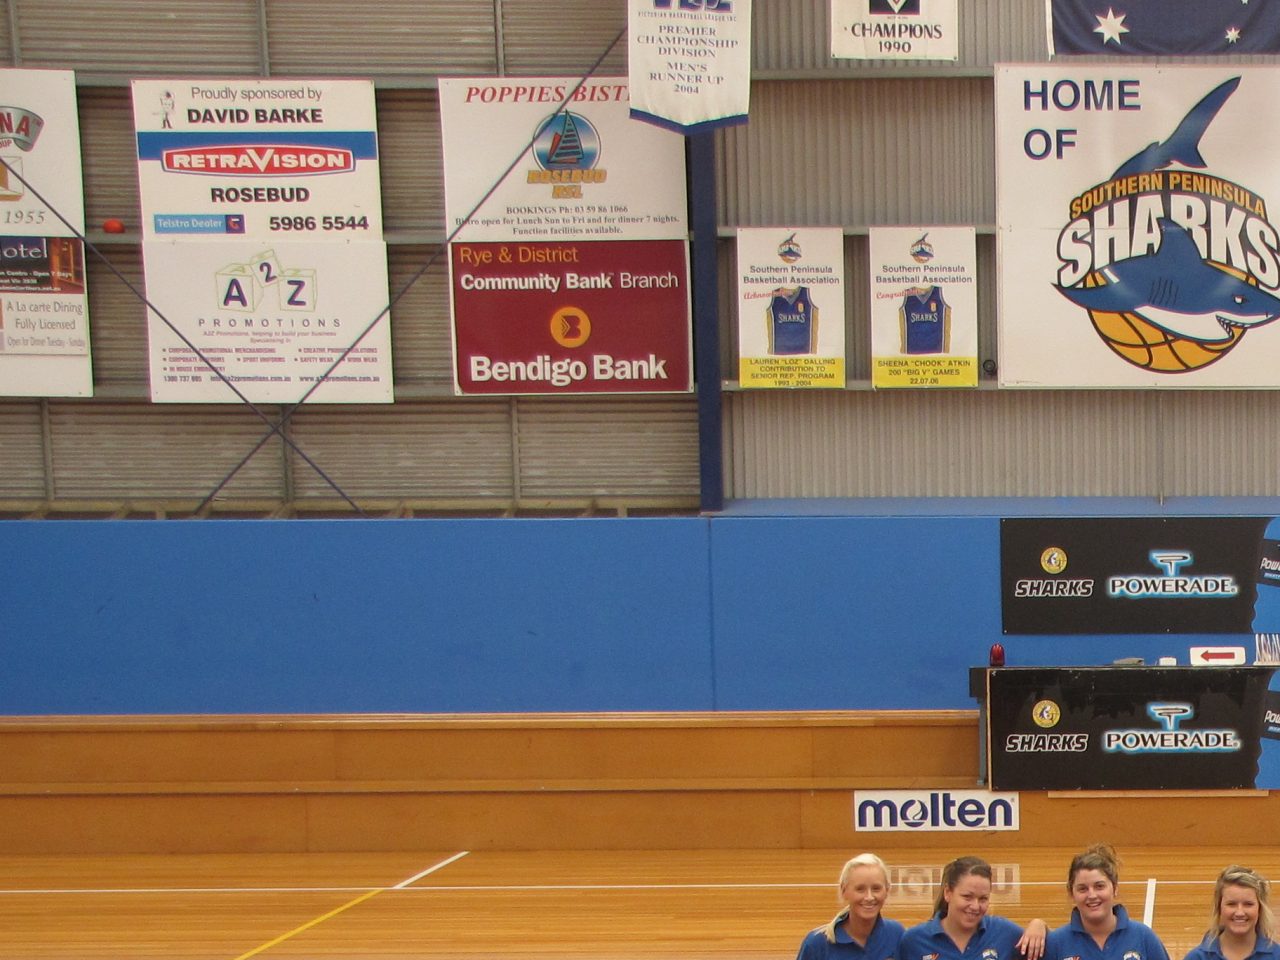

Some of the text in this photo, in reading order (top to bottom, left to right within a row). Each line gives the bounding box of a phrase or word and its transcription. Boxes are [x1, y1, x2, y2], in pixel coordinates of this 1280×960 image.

[659, 26, 716, 36] PREMIER
[852, 23, 942, 39] CHAMPIONS
[637, 36, 738, 48] CHAMPIONSHIP
[878, 41, 911, 53] 1990
[658, 48, 716, 58] DIVISION
[667, 62, 707, 72] MEN'S
[650, 73, 724, 85] RUNNER UP
[191, 87, 322, 101] Proudly sponsored by
[466, 85, 630, 103] POPPIES BIST
[674, 85, 699, 94] 2004
[1024, 79, 1141, 111] HOME
[188, 109, 323, 124] DAVID BARKE
[1024, 129, 1077, 160] OF
[173, 149, 345, 172] RETRAVISION
[211, 188, 309, 202] ROSEBUD
[1071, 173, 1265, 219] SOUTHERN PENINSULA
[5, 210, 45, 224] 1955
[158, 219, 222, 229] Telstra Dealer
[269, 217, 369, 230] 5986 5544
[1057, 194, 1280, 290] SHARKS
[460, 247, 578, 267] Rye & District
[882, 265, 965, 273] Southern Peninsula
[461, 272, 678, 292] Community Bank Branch
[876, 276, 919, 284] Basketball
[199, 319, 341, 328] PROMOTIONS
[470, 354, 667, 386] Bendigo Bank
[1015, 579, 1094, 597] SHARKS
[1111, 578, 1232, 594] POWERADE
[1006, 734, 1089, 751] SHARKS
[1106, 731, 1232, 748] POWERADE
[858, 793, 1012, 827] molten
